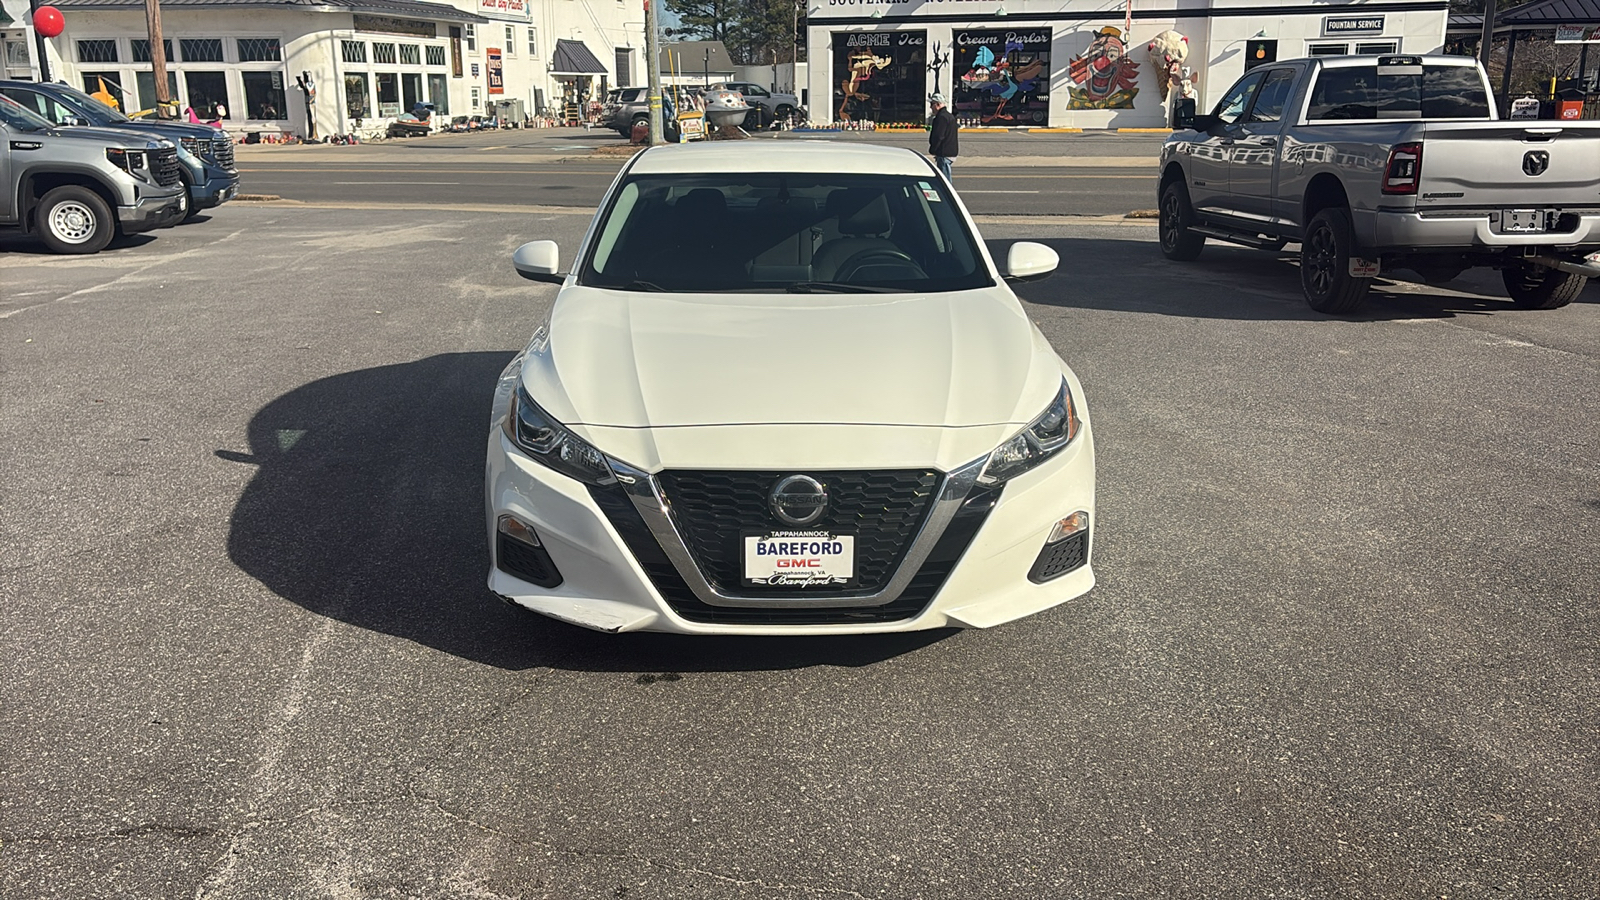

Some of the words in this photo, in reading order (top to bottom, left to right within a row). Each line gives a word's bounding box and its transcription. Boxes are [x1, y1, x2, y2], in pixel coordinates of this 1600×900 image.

[1328, 21, 1357, 29] FOUNTAIN
[1358, 20, 1381, 29] SERVICE
[847, 33, 890, 46] ACME
[898, 33, 924, 45] Ice
[957, 32, 999, 45] Cream
[1005, 32, 1049, 44] Parlor
[776, 495, 820, 504] NISSAN
[757, 542, 842, 555] BAREFORD
[777, 559, 820, 567] GMC
[768, 574, 833, 588] Bareford
